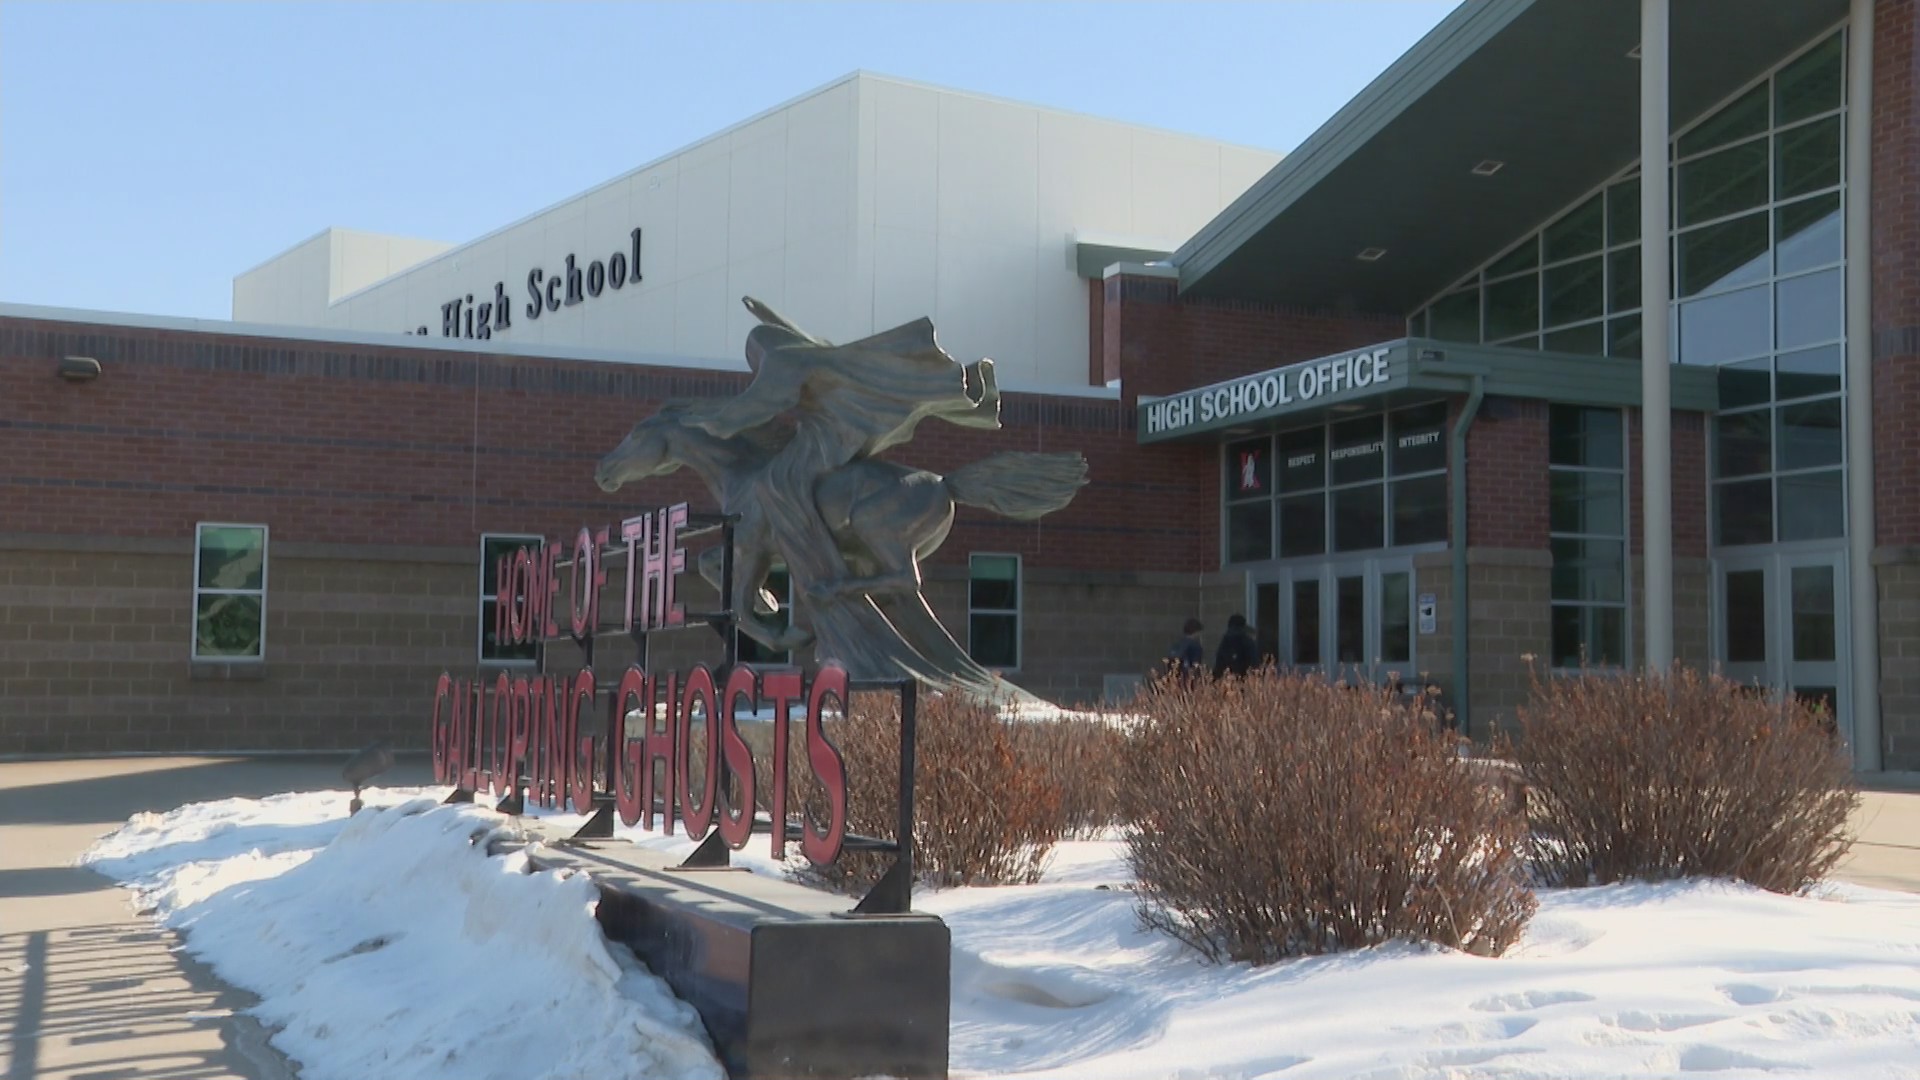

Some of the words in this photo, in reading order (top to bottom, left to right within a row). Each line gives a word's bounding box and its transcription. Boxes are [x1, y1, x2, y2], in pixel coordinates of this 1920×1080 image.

[441, 282, 511, 340] High
[526, 227, 643, 320] School
[1147, 396, 1195, 434] HIGH
[1200, 373, 1293, 423] SCHOOL
[1298, 347, 1391, 400] OFFICE
[1288, 453, 1316, 468] RESPECT
[1331, 441, 1384, 461] RESPONSIBILITY
[1399, 431, 1440, 448] INTEGRITY
[495, 541, 562, 646] HOME
[571, 524, 610, 640] OF
[620, 501, 689, 634] THE
[433, 667, 596, 816] GALLOPING
[615, 660, 849, 866] GHOSTS
